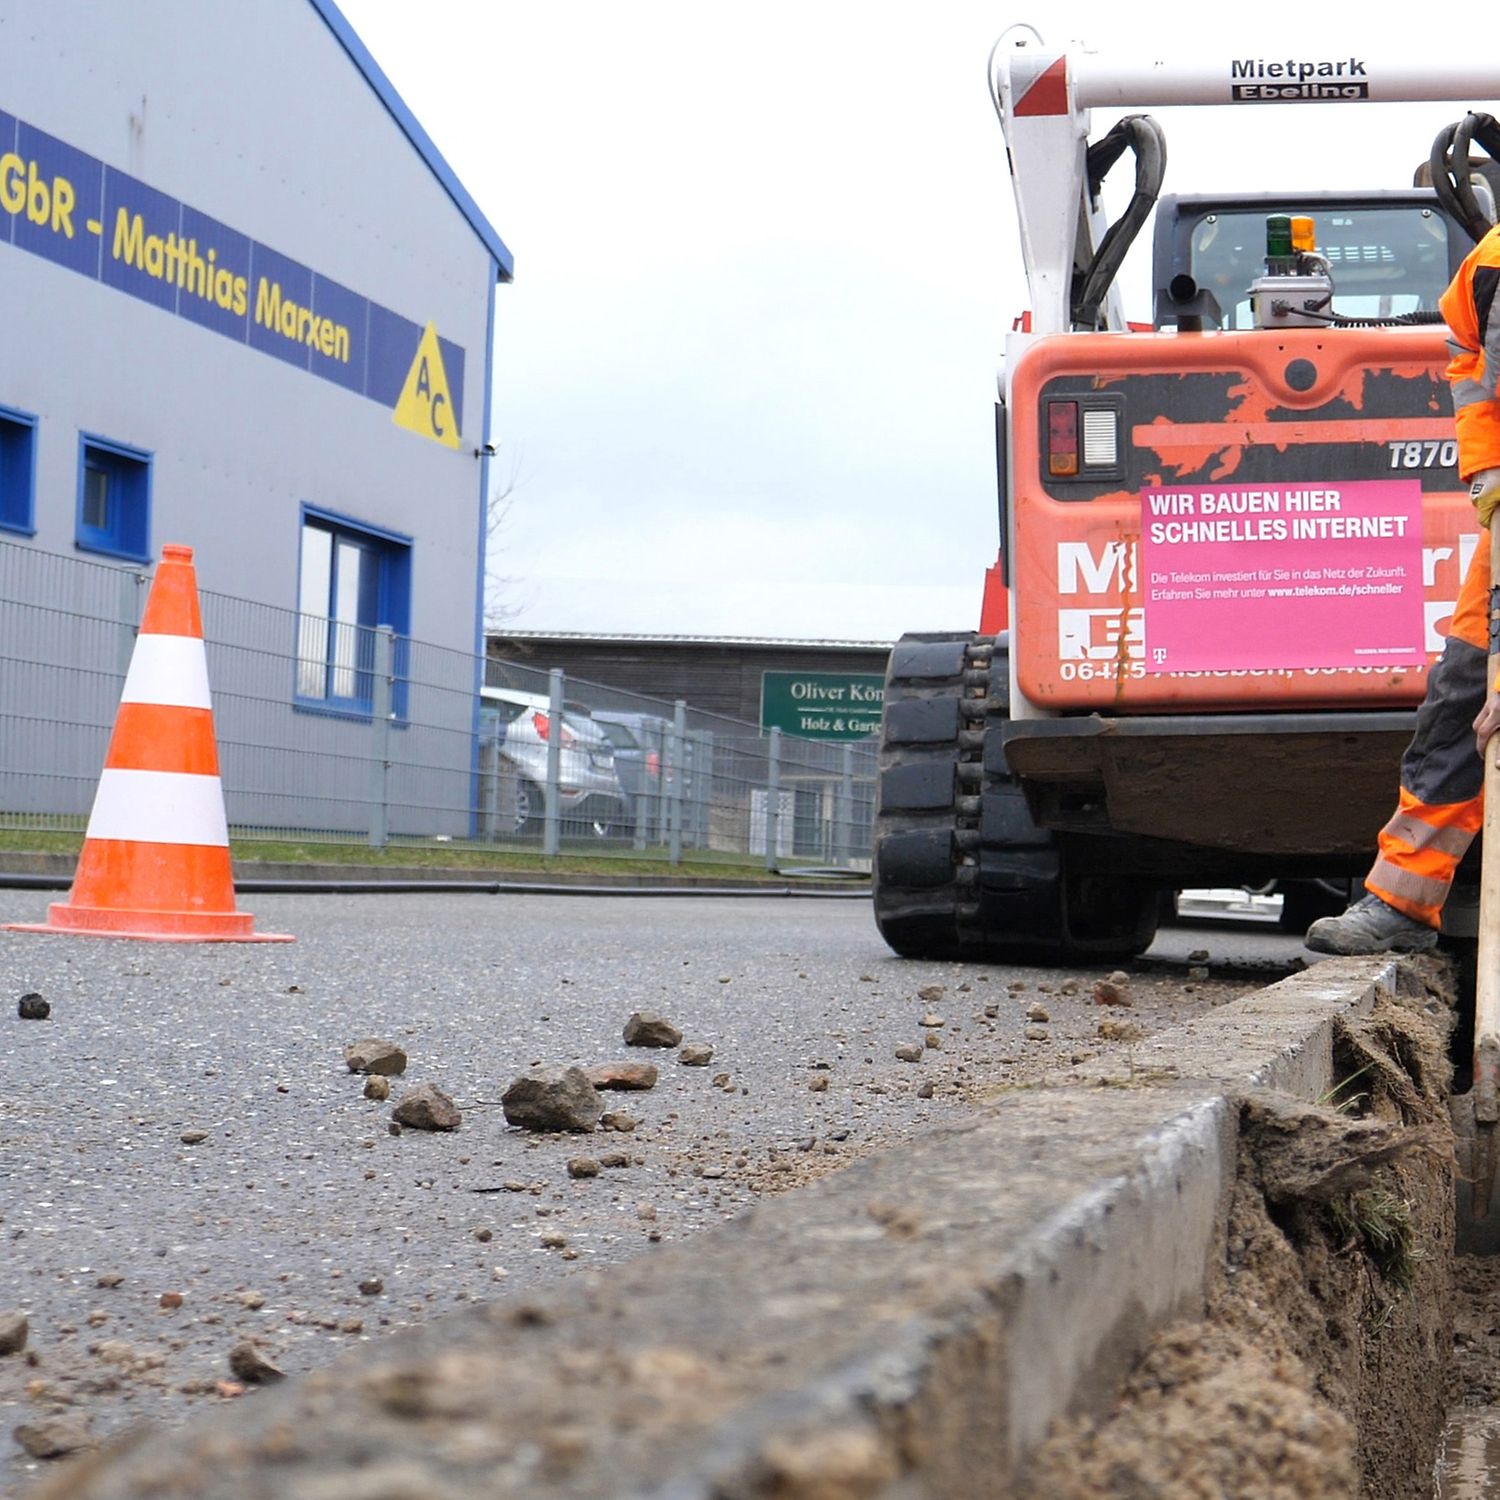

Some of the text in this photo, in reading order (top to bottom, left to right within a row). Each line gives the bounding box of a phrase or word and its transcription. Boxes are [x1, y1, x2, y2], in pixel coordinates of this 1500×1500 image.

[1231, 57, 1367, 82] Mietpark
[1240, 84, 1361, 99] Ebeling
[0, 153, 75, 239] GbR
[112, 207, 247, 317] Matthias
[255, 277, 350, 363] Marxen
[1389, 440, 1458, 468] T870
[1149, 490, 1341, 516] WIR BAUEN HIER
[1150, 516, 1408, 544] SCHNELLES INTERNET
[1151, 565, 1406, 584] Die Telekom investiert für Sie in das Netz der Zukunft.
[1151, 583, 1403, 601] Erfahren Sie mehr unter www.telekom.de/schneller
[790, 682, 885, 702] Oliver Kön
[801, 717, 882, 733] Holz & Garte
